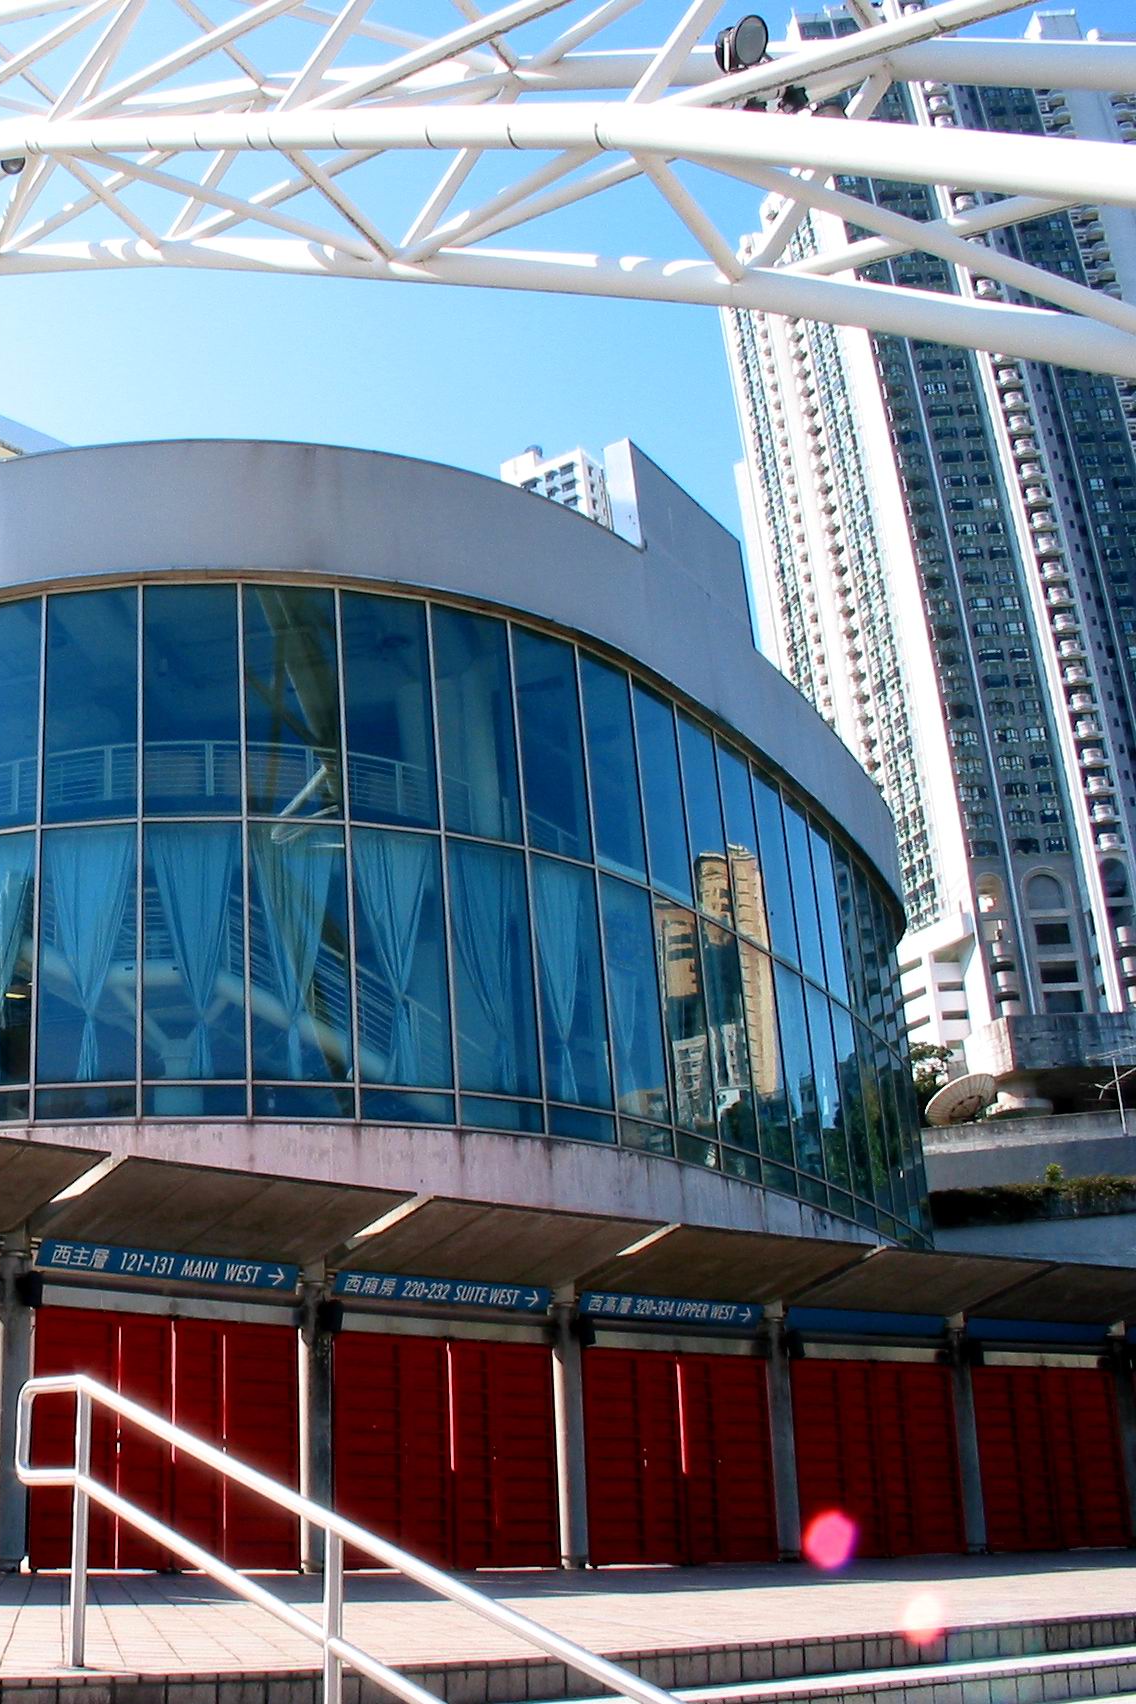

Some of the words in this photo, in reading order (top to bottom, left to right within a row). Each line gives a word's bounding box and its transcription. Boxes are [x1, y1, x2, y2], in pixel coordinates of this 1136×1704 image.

[51, 1244, 110, 1269] 西主層
[120, 1252, 175, 1275] 121-131
[180, 1259, 218, 1279] MAIN
[224, 1263, 262, 1284] WEST
[401, 1280, 451, 1300] 220-232
[453, 1284, 489, 1303] SUITE
[489, 1287, 521, 1305] WEST
[588, 1294, 633, 1314] 西高層
[634, 1298, 675, 1316] 320-334
[676, 1301, 708, 1318] UPPER
[710, 1304, 737, 1320] WEST
